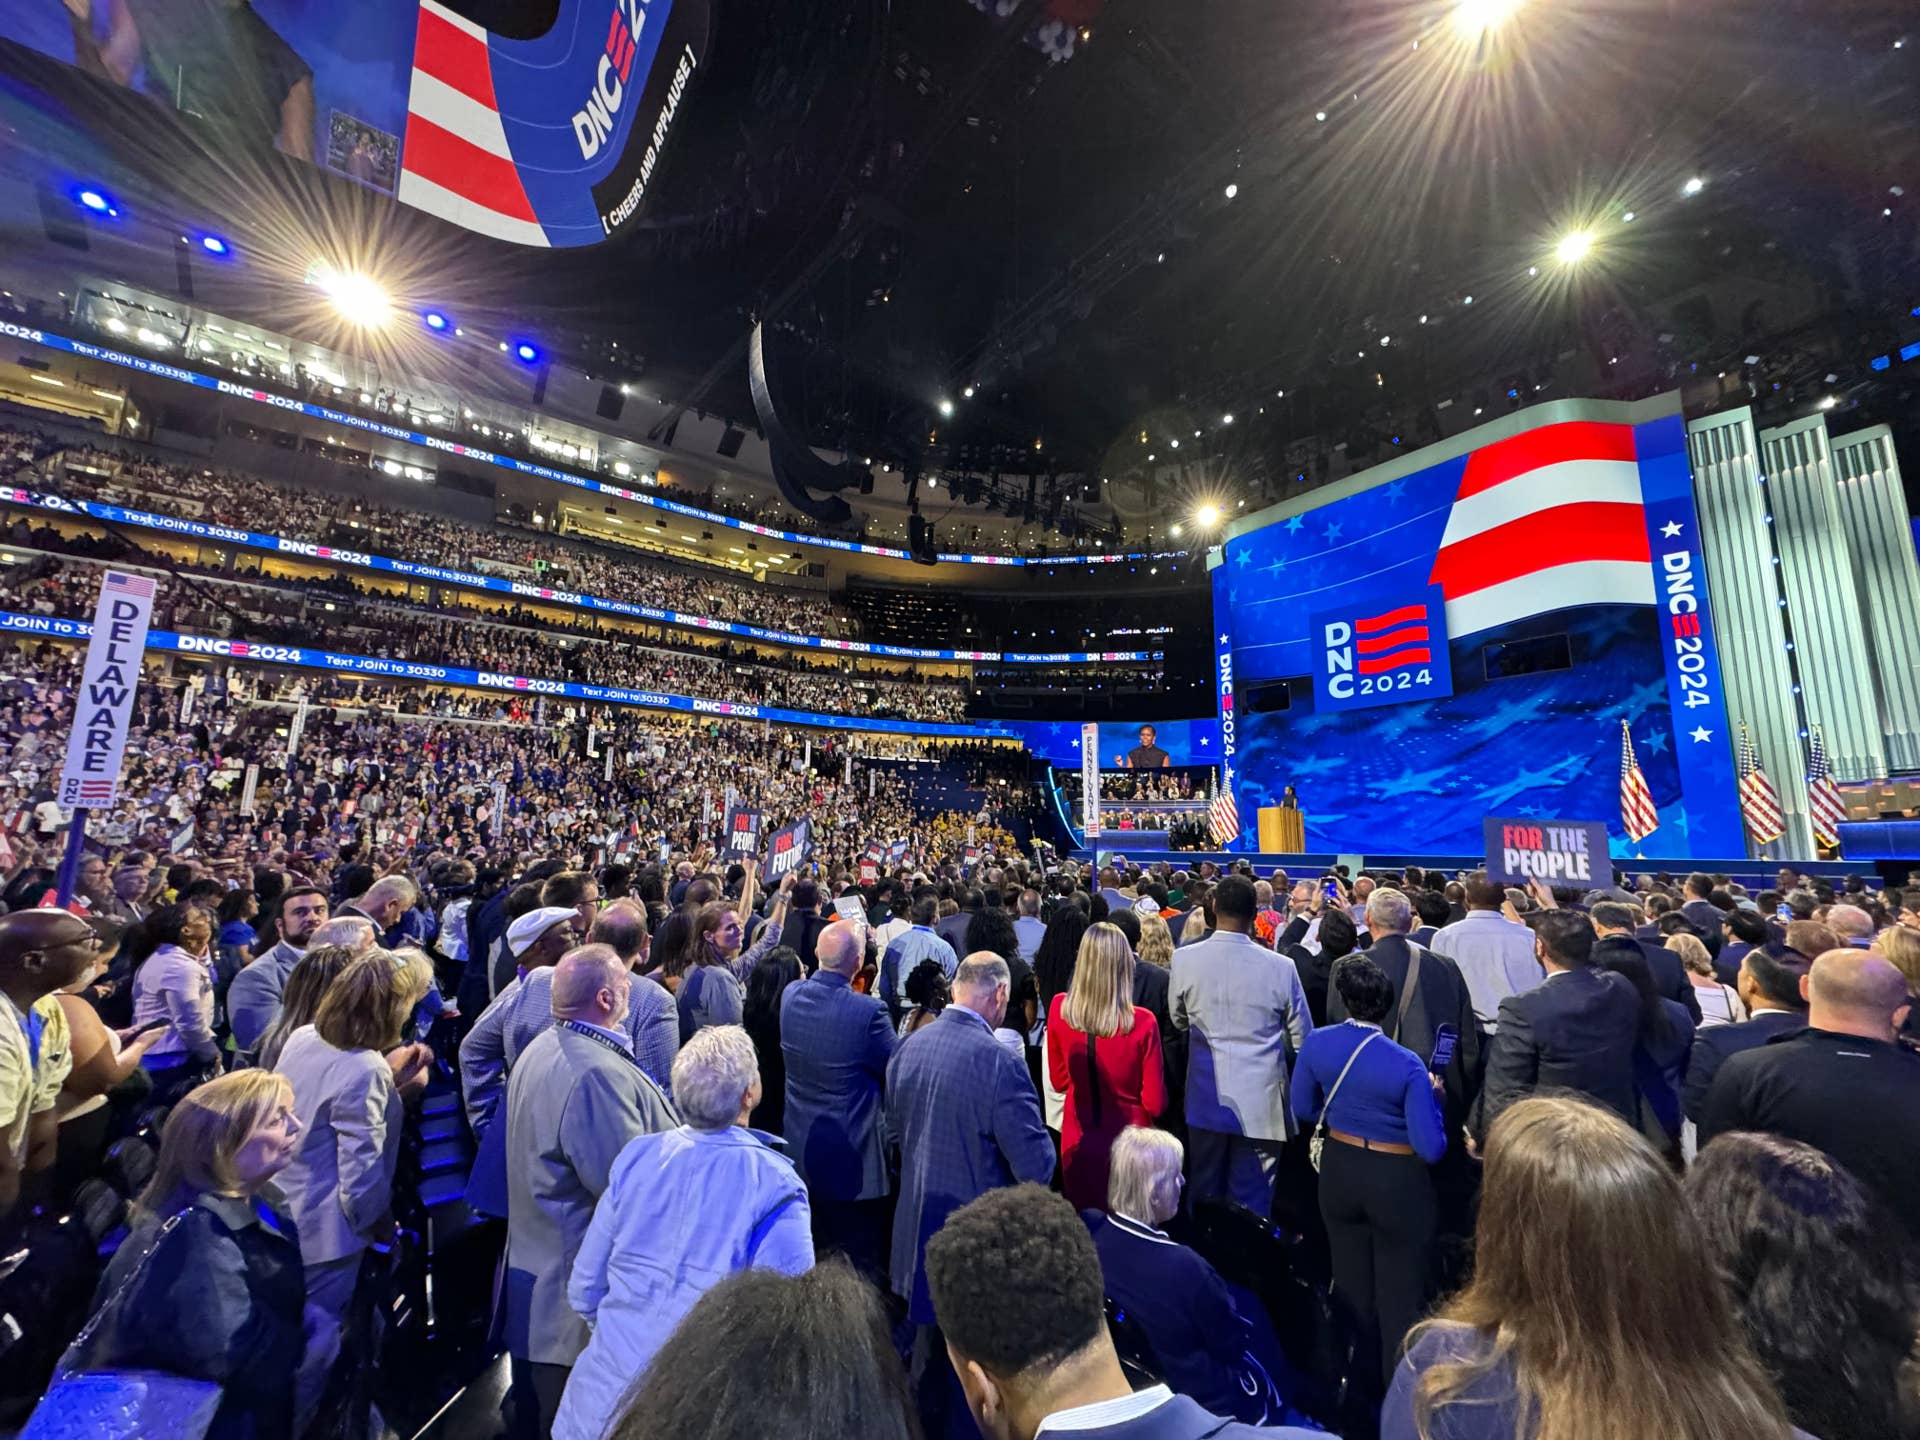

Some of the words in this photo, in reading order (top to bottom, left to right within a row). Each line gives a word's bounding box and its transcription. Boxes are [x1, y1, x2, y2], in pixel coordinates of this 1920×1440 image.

[609, 178, 644, 226] CHEERS
[640, 145, 656, 186] AND
[652, 55, 691, 152] APPLAUSE
[72, 342, 98, 357] Text
[100, 350, 132, 366] JOIN
[134, 357, 147, 369] to
[149, 362, 188, 380] 30330
[266, 394, 304, 412] 2024
[322, 409, 343, 423] Text
[344, 416, 369, 429] JOIN
[464, 448, 494, 463] 2024
[630, 491, 654, 505] 2024
[124, 511, 150, 525] Text
[154, 517, 189, 532] JOIN
[192, 525, 206, 535] to
[208, 527, 249, 541] 30330
[764, 528, 785, 540] 2024
[331, 550, 371, 566] 2024
[391, 561, 413, 573] Text
[414, 566, 440, 579] JOIN
[551, 591, 582, 605] 2024
[2, 615, 49, 633] JOIN
[54, 622, 72, 633] to
[707, 620, 731, 632] 2024
[248, 645, 301, 663] 2024
[848, 642, 870, 653] 2024
[325, 655, 354, 667] Text
[356, 659, 389, 673] JOIN
[391, 665, 405, 673] to
[407, 665, 446, 678] 30330
[1325, 621, 1354, 698] DNC
[1360, 669, 1433, 695] 2024
[1675, 637, 1710, 709] 2024
[82, 600, 140, 772] DELAWARE
[528, 679, 565, 694] 2024
[582, 687, 603, 698] Text
[604, 689, 628, 700] JOIN
[630, 693, 639, 701] to
[640, 693, 670, 705] 30330
[730, 704, 759, 718] 2024
[1223, 709, 1235, 757] 2024
[63, 778, 79, 804] DNC
[734, 813, 749, 831] FOR
[774, 831, 792, 855] FOR
[1503, 824, 1544, 850] FOR
[1546, 826, 1589, 854] THE
[1503, 848, 1592, 882] PEOPLE
